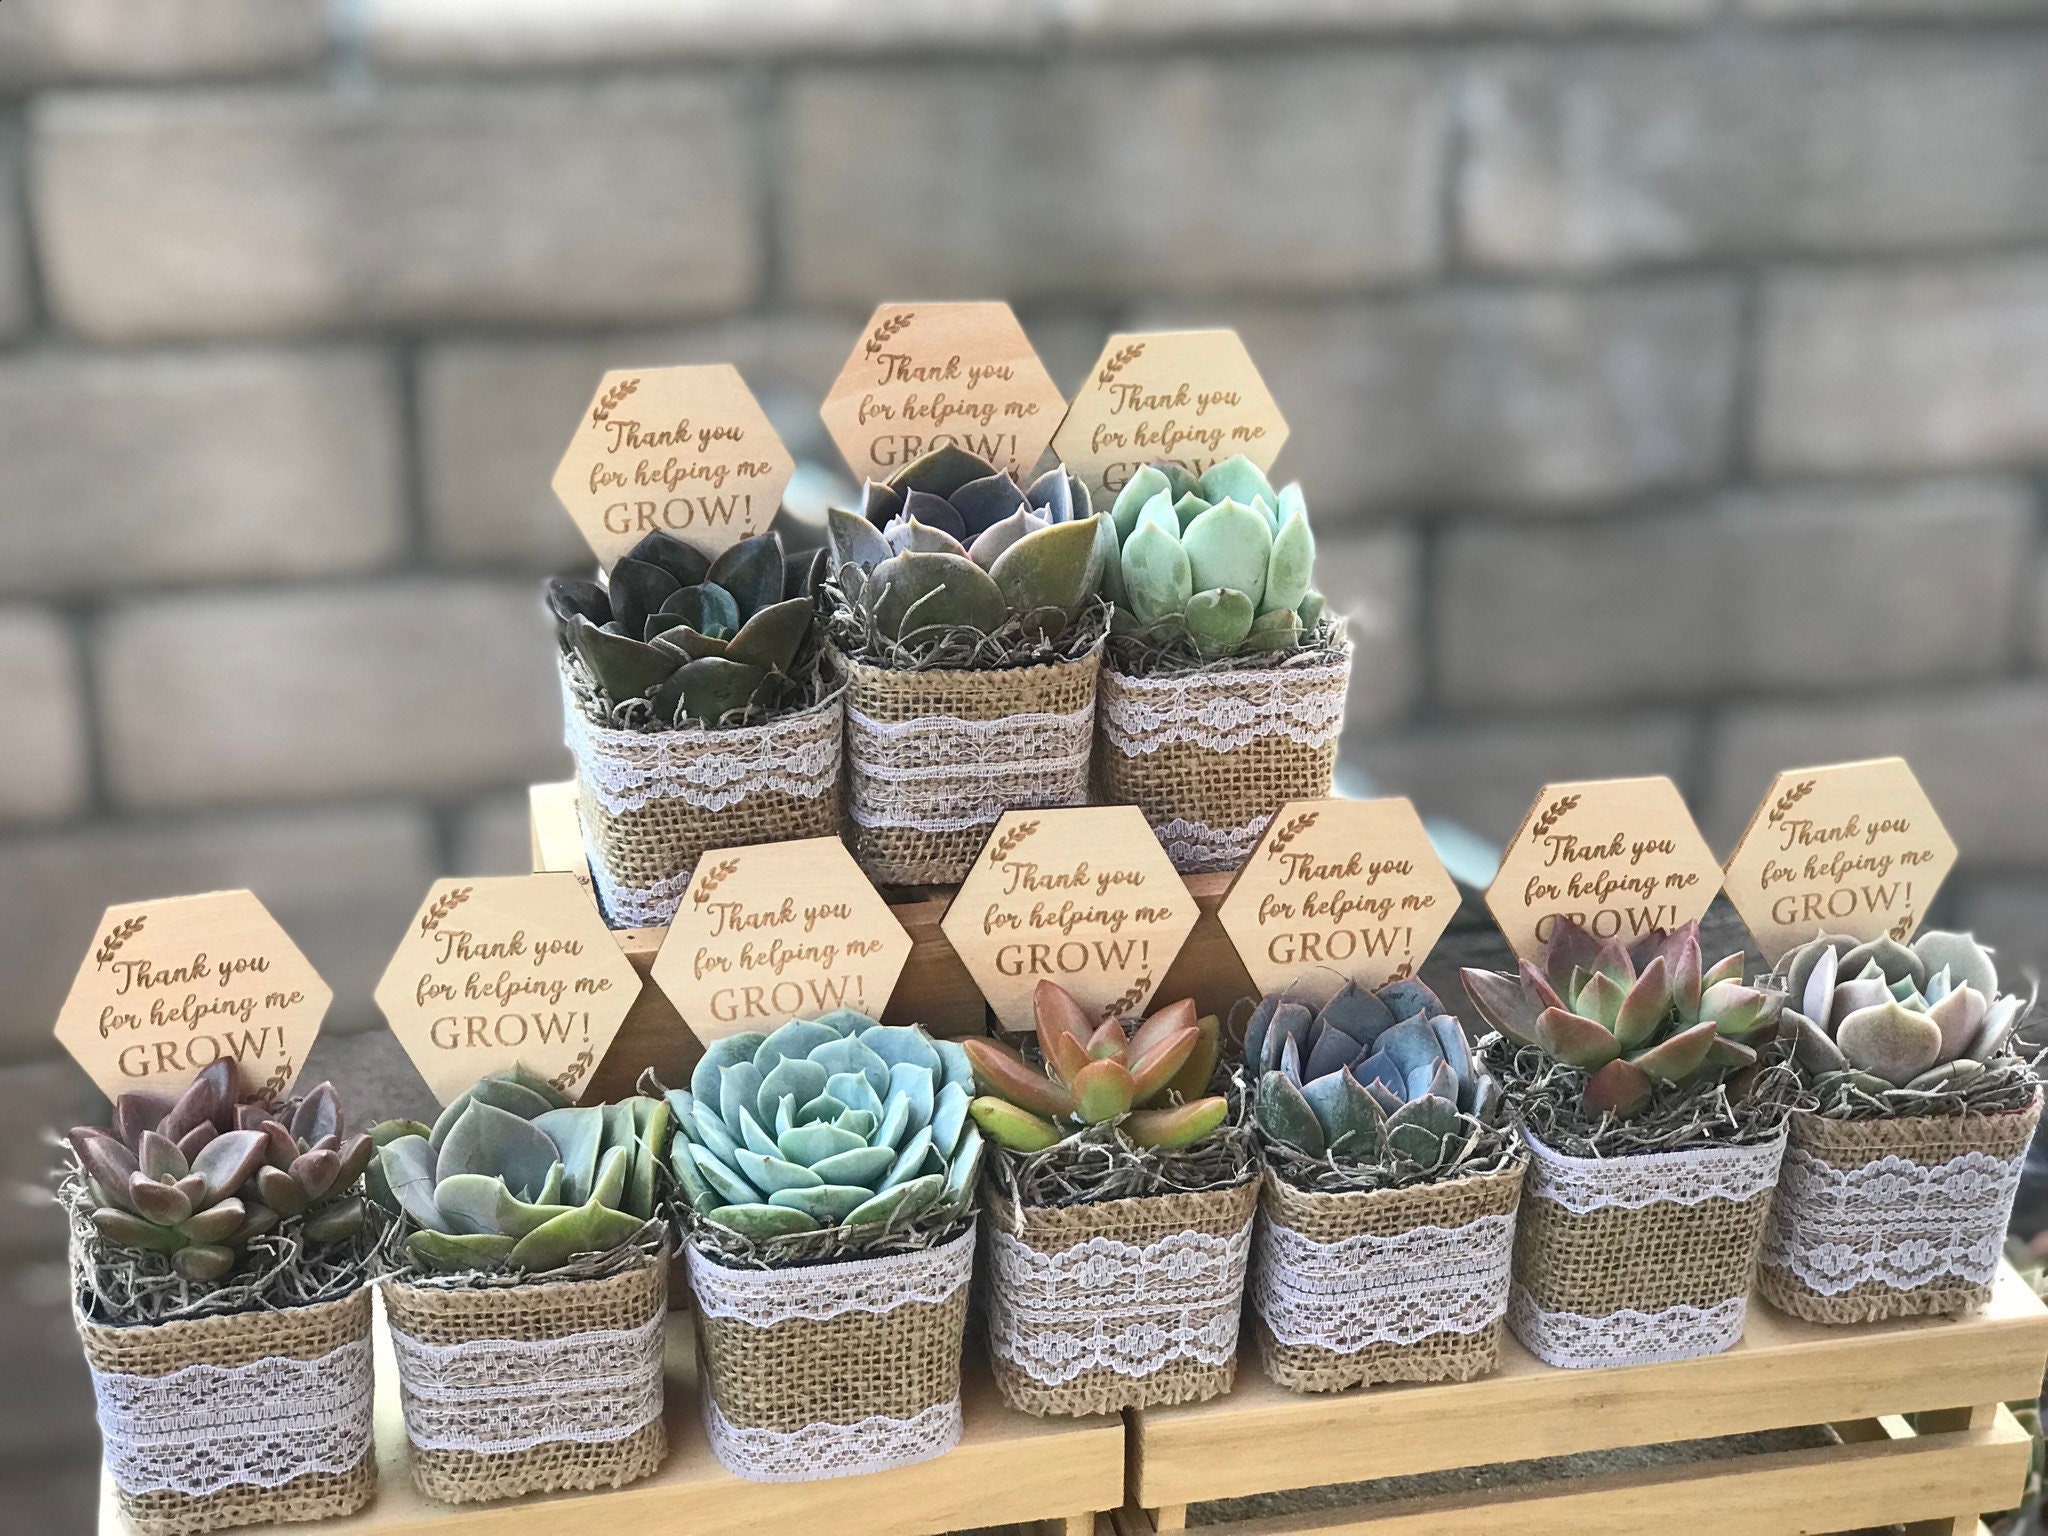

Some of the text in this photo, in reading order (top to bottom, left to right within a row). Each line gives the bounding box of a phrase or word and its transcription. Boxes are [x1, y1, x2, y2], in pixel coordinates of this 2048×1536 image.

[877, 355, 1014, 390] Thank you
[858, 393, 1040, 427] for helping me
[1109, 383, 1241, 416] Thank you
[605, 418, 744, 454] Thank you
[1092, 420, 1266, 454] for helping me
[590, 457, 771, 494] for helping me
[604, 494, 751, 534] GROW!
[1544, 832, 1675, 867] Thank you
[1780, 814, 1911, 851] Thank you
[1002, 862, 1145, 897] Thank you
[1280, 851, 1413, 886] Thank you
[1761, 850, 1934, 890] for helping me
[1525, 870, 1699, 906] for helping me
[1771, 882, 1912, 925] GROW!
[706, 897, 852, 937] Thank you
[984, 900, 1173, 935] for helping me
[1258, 889, 1436, 925] for helping me
[434, 930, 583, 966] Thank you
[694, 938, 883, 980] for helping me
[995, 939, 1149, 976] GROW!
[1268, 926, 1412, 965] GROW!
[111, 952, 270, 995] Thank you
[416, 970, 613, 1008] for helping me
[99, 991, 305, 1039] for helping me
[709, 974, 865, 1022] GROW!
[430, 1011, 590, 1050] GROW!
[117, 1026, 286, 1078] GROW!
